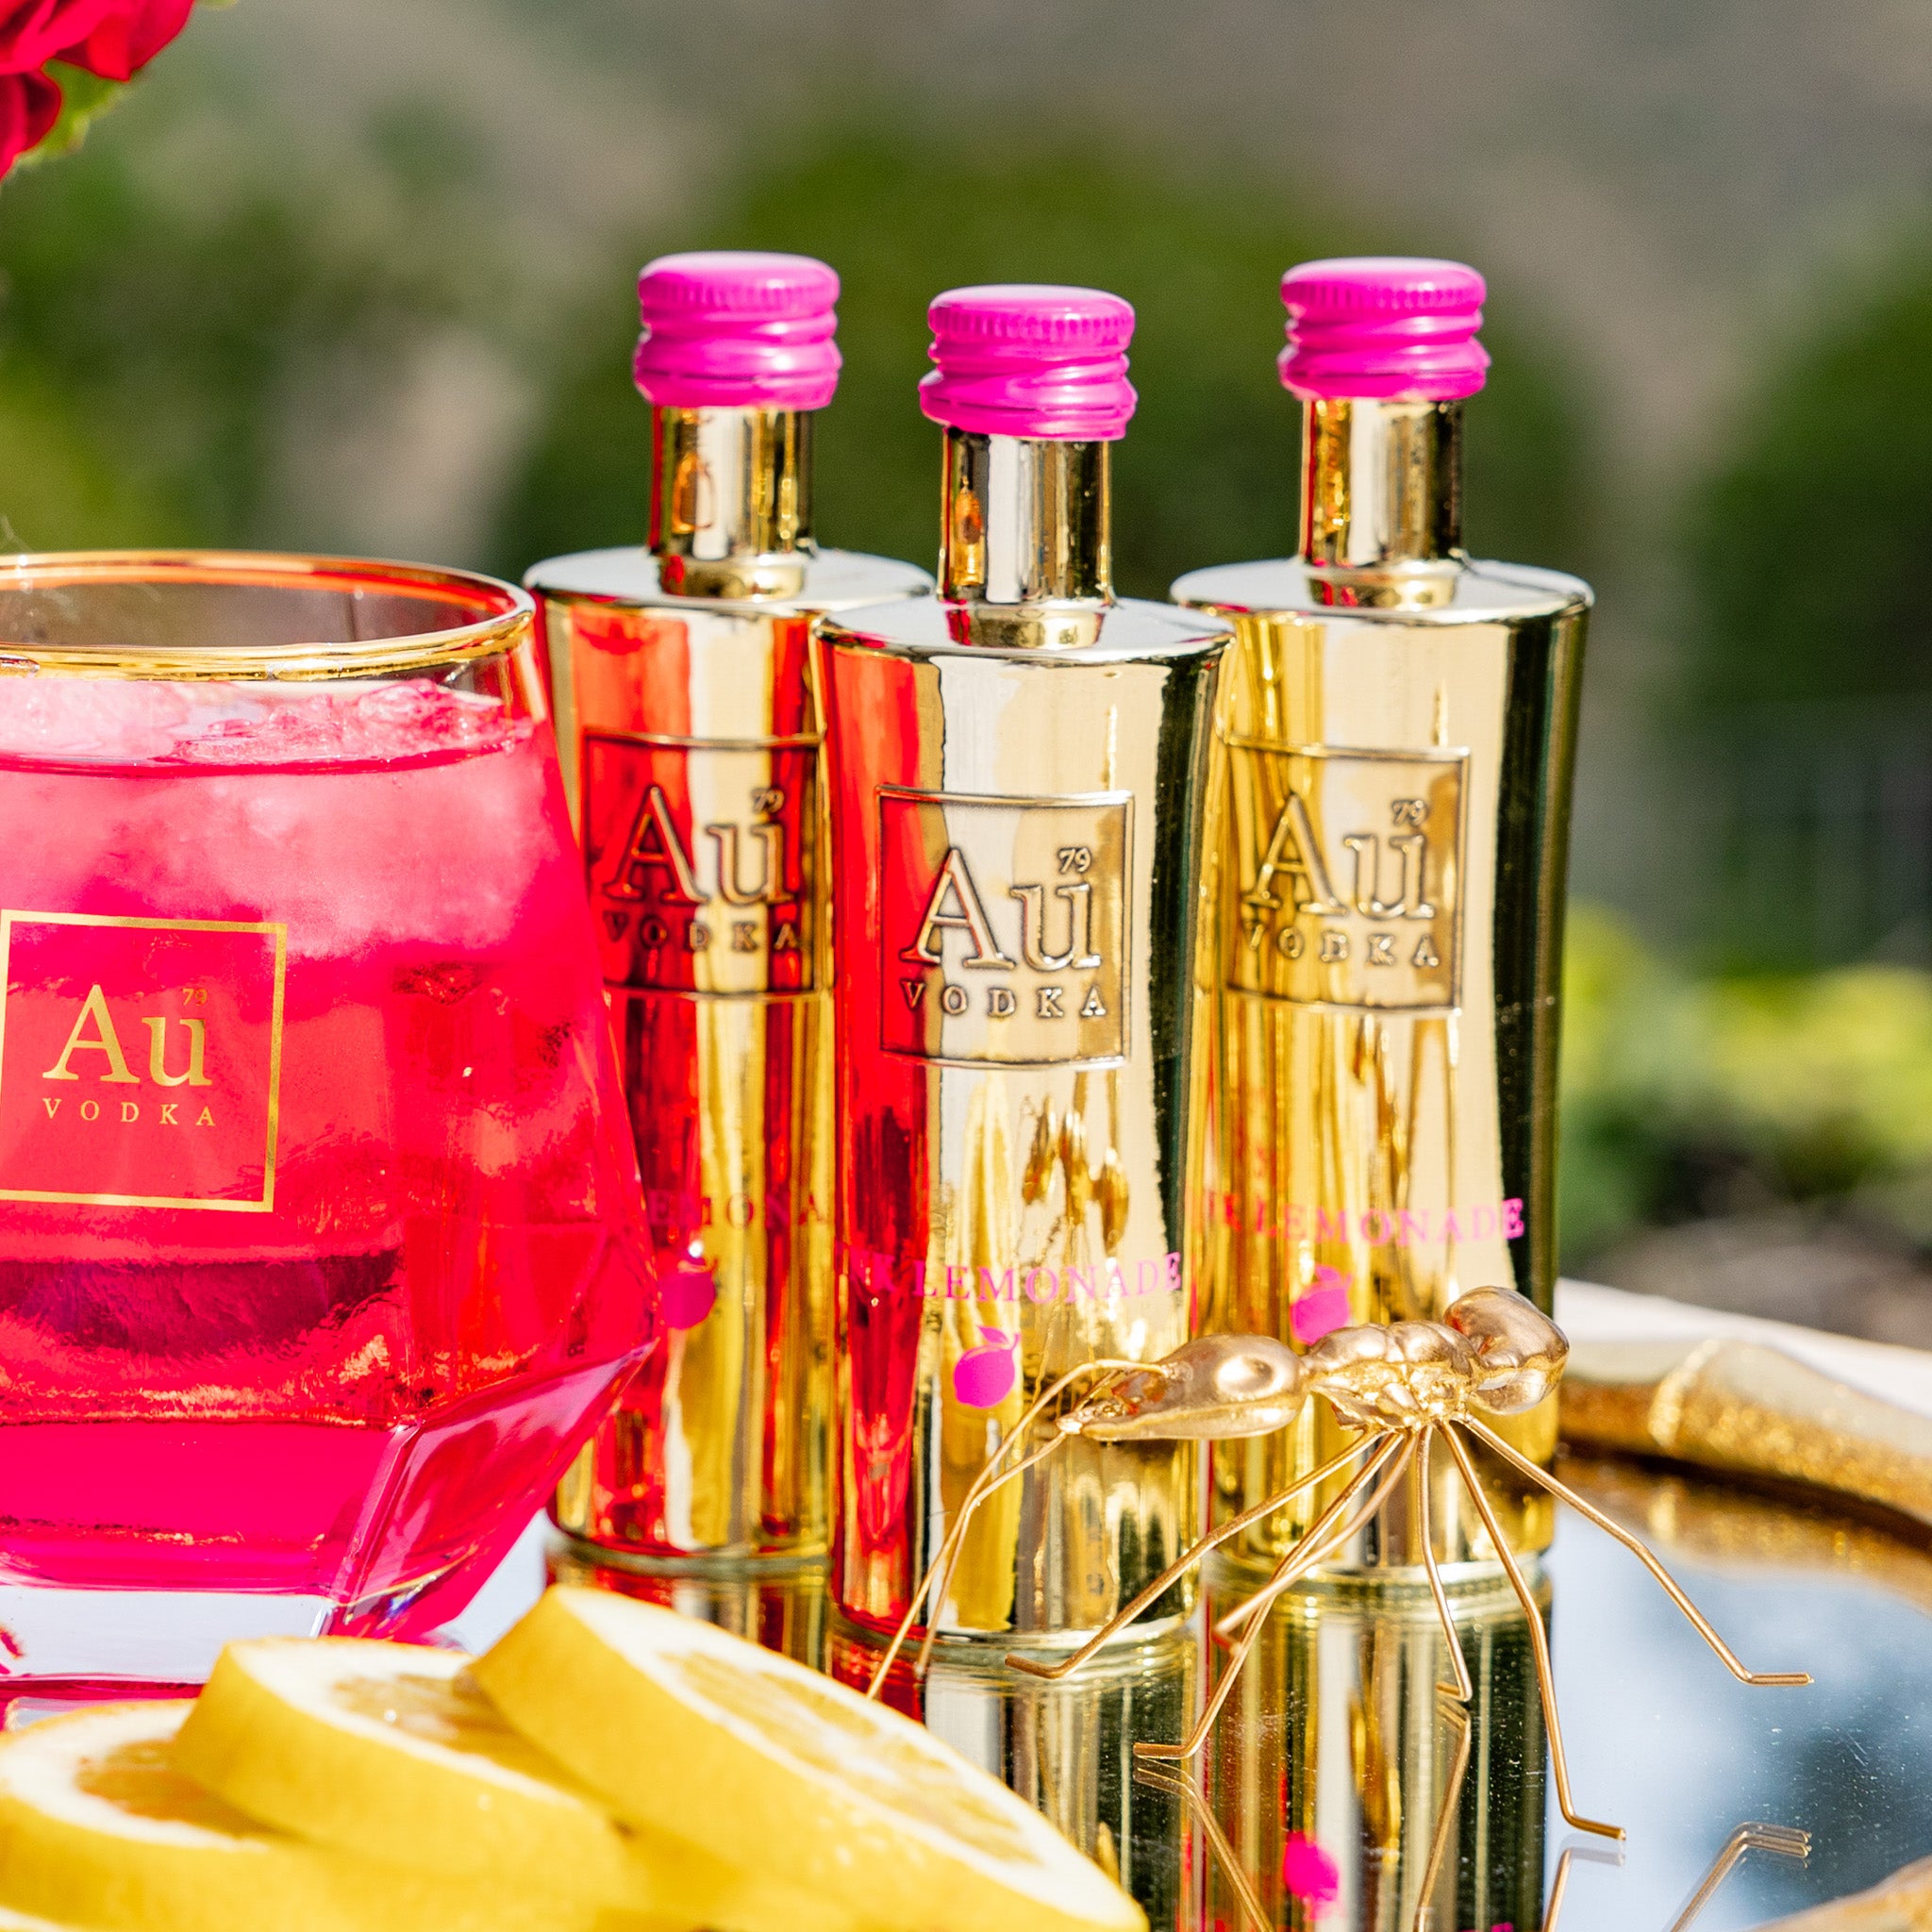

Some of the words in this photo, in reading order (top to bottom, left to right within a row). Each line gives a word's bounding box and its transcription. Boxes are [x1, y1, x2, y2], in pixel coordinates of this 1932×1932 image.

[750, 787, 785, 813] 79
[1391, 799, 1429, 827] 79
[602, 784, 798, 908] Au
[1056, 847, 1091, 874] 79
[1241, 792, 1436, 921] Au
[602, 909, 800, 952] VODKA
[899, 847, 1102, 972] Au
[1241, 919, 1440, 967] VODKA
[182, 988, 208, 1007] 79
[900, 978, 1108, 1019] VODKA
[42, 984, 213, 1087] Au
[42, 1097, 216, 1126] VODKA
[1254, 1196, 1525, 1247] LEMONADE
[912, 1251, 1183, 1306] LEMONADE
